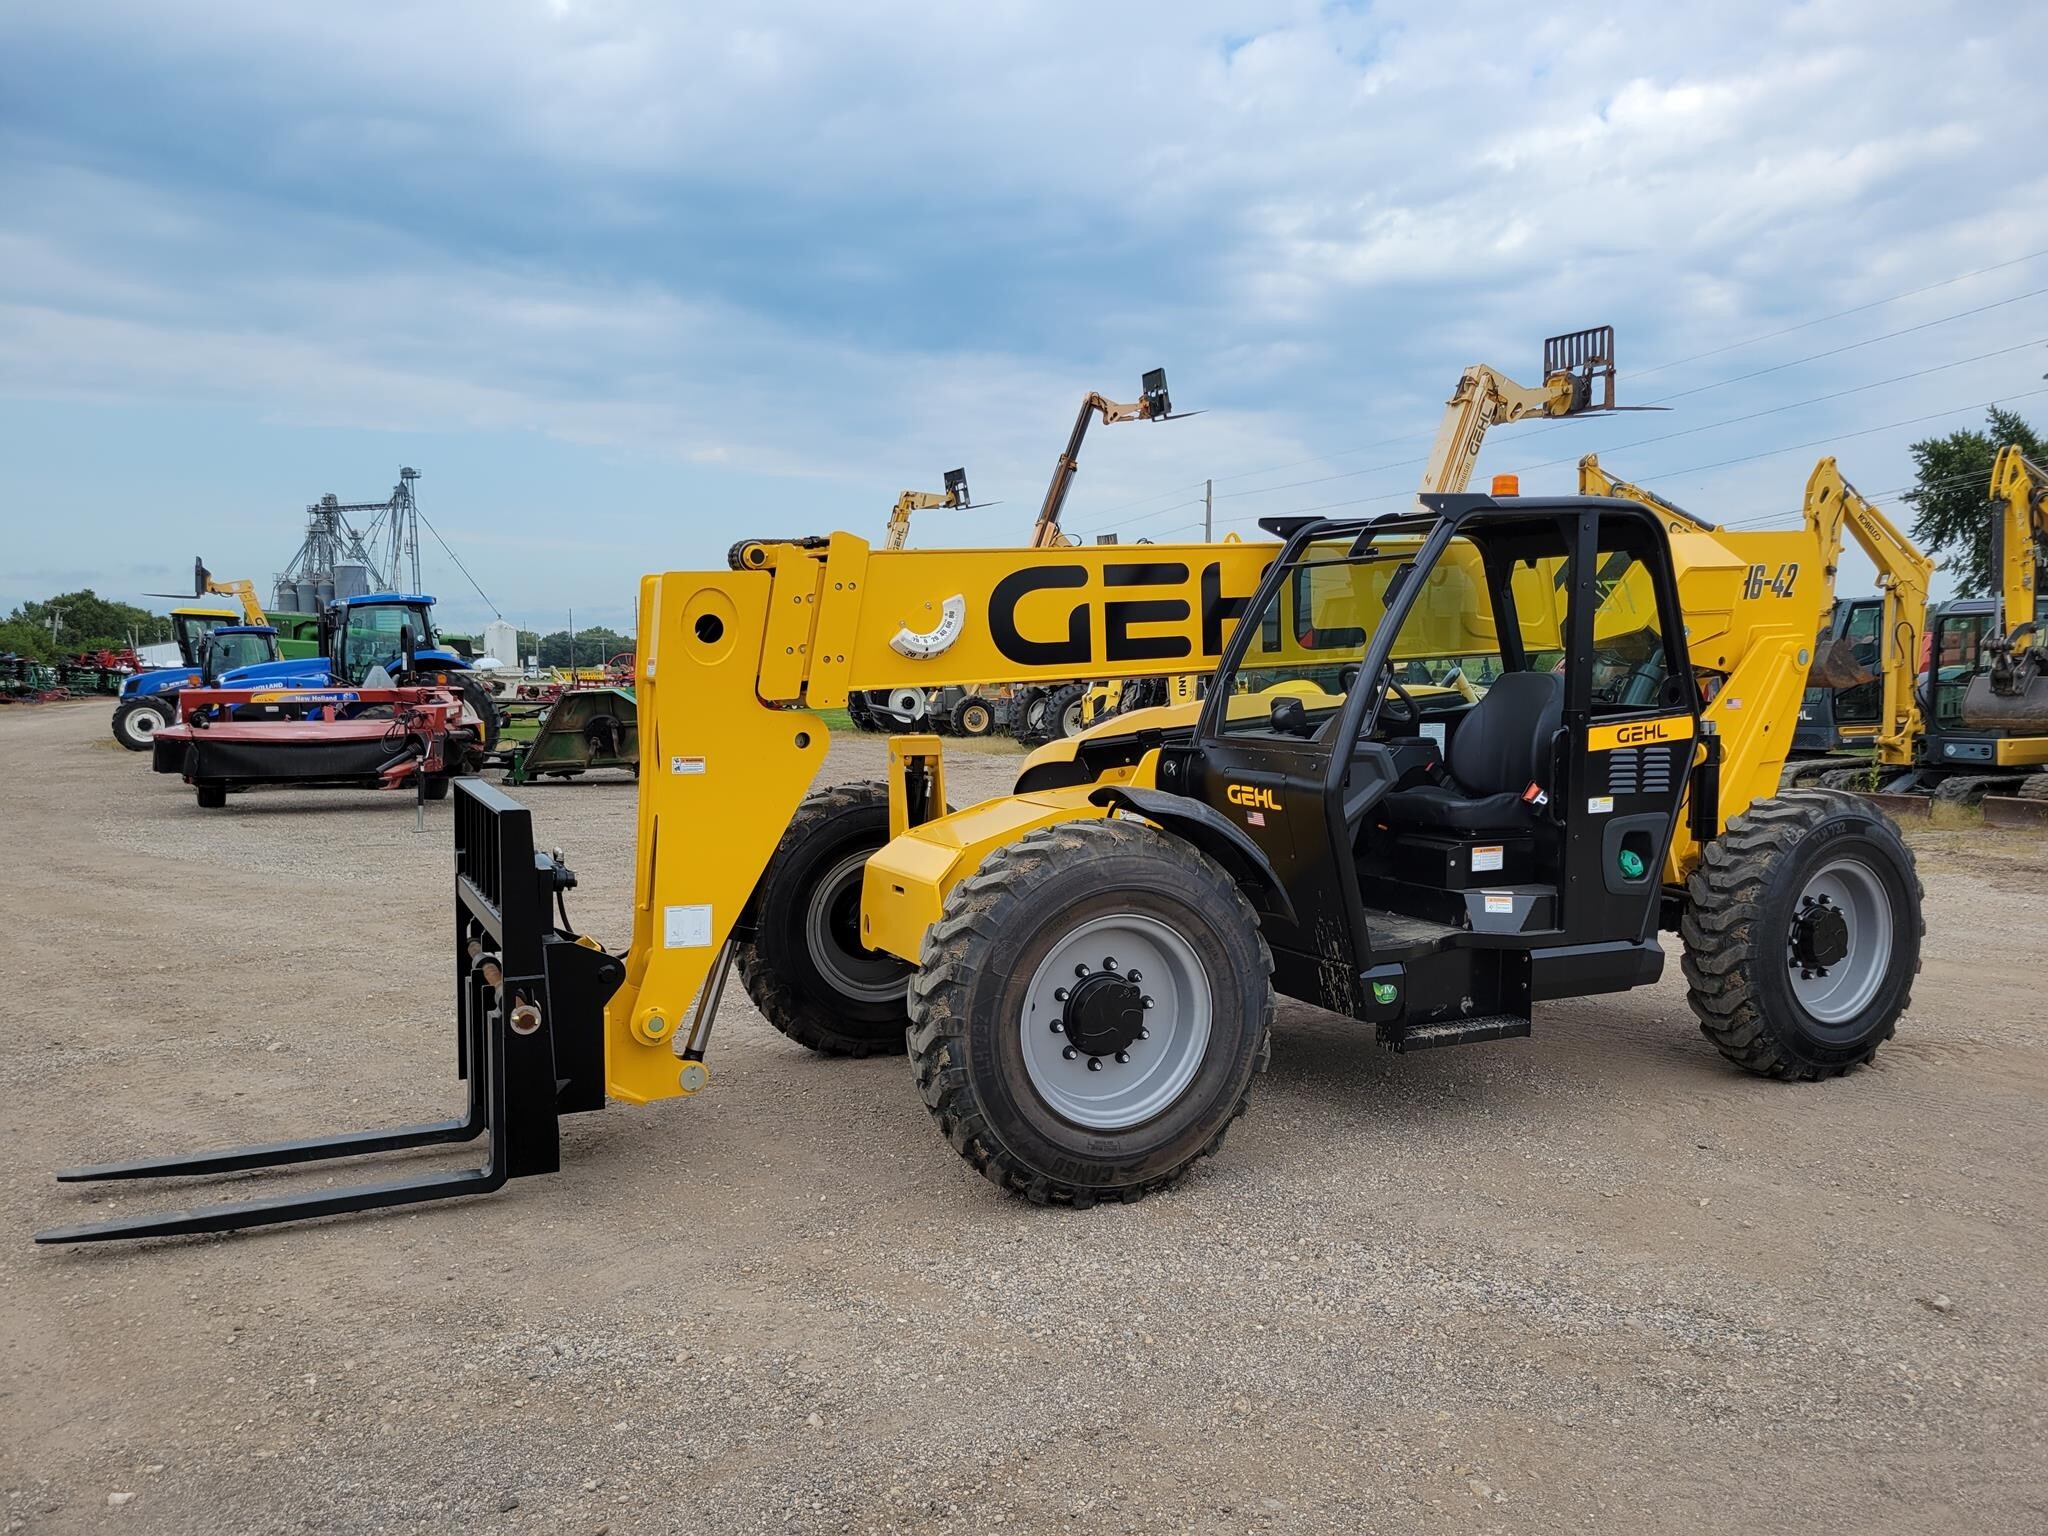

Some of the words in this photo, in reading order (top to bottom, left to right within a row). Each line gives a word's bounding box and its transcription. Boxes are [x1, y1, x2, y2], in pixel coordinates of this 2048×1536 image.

[1469, 408, 1493, 456] GEHL
[988, 561, 1367, 666] GEHL
[1617, 724, 1668, 743] GEHL
[1227, 784, 1282, 811] GEHL
